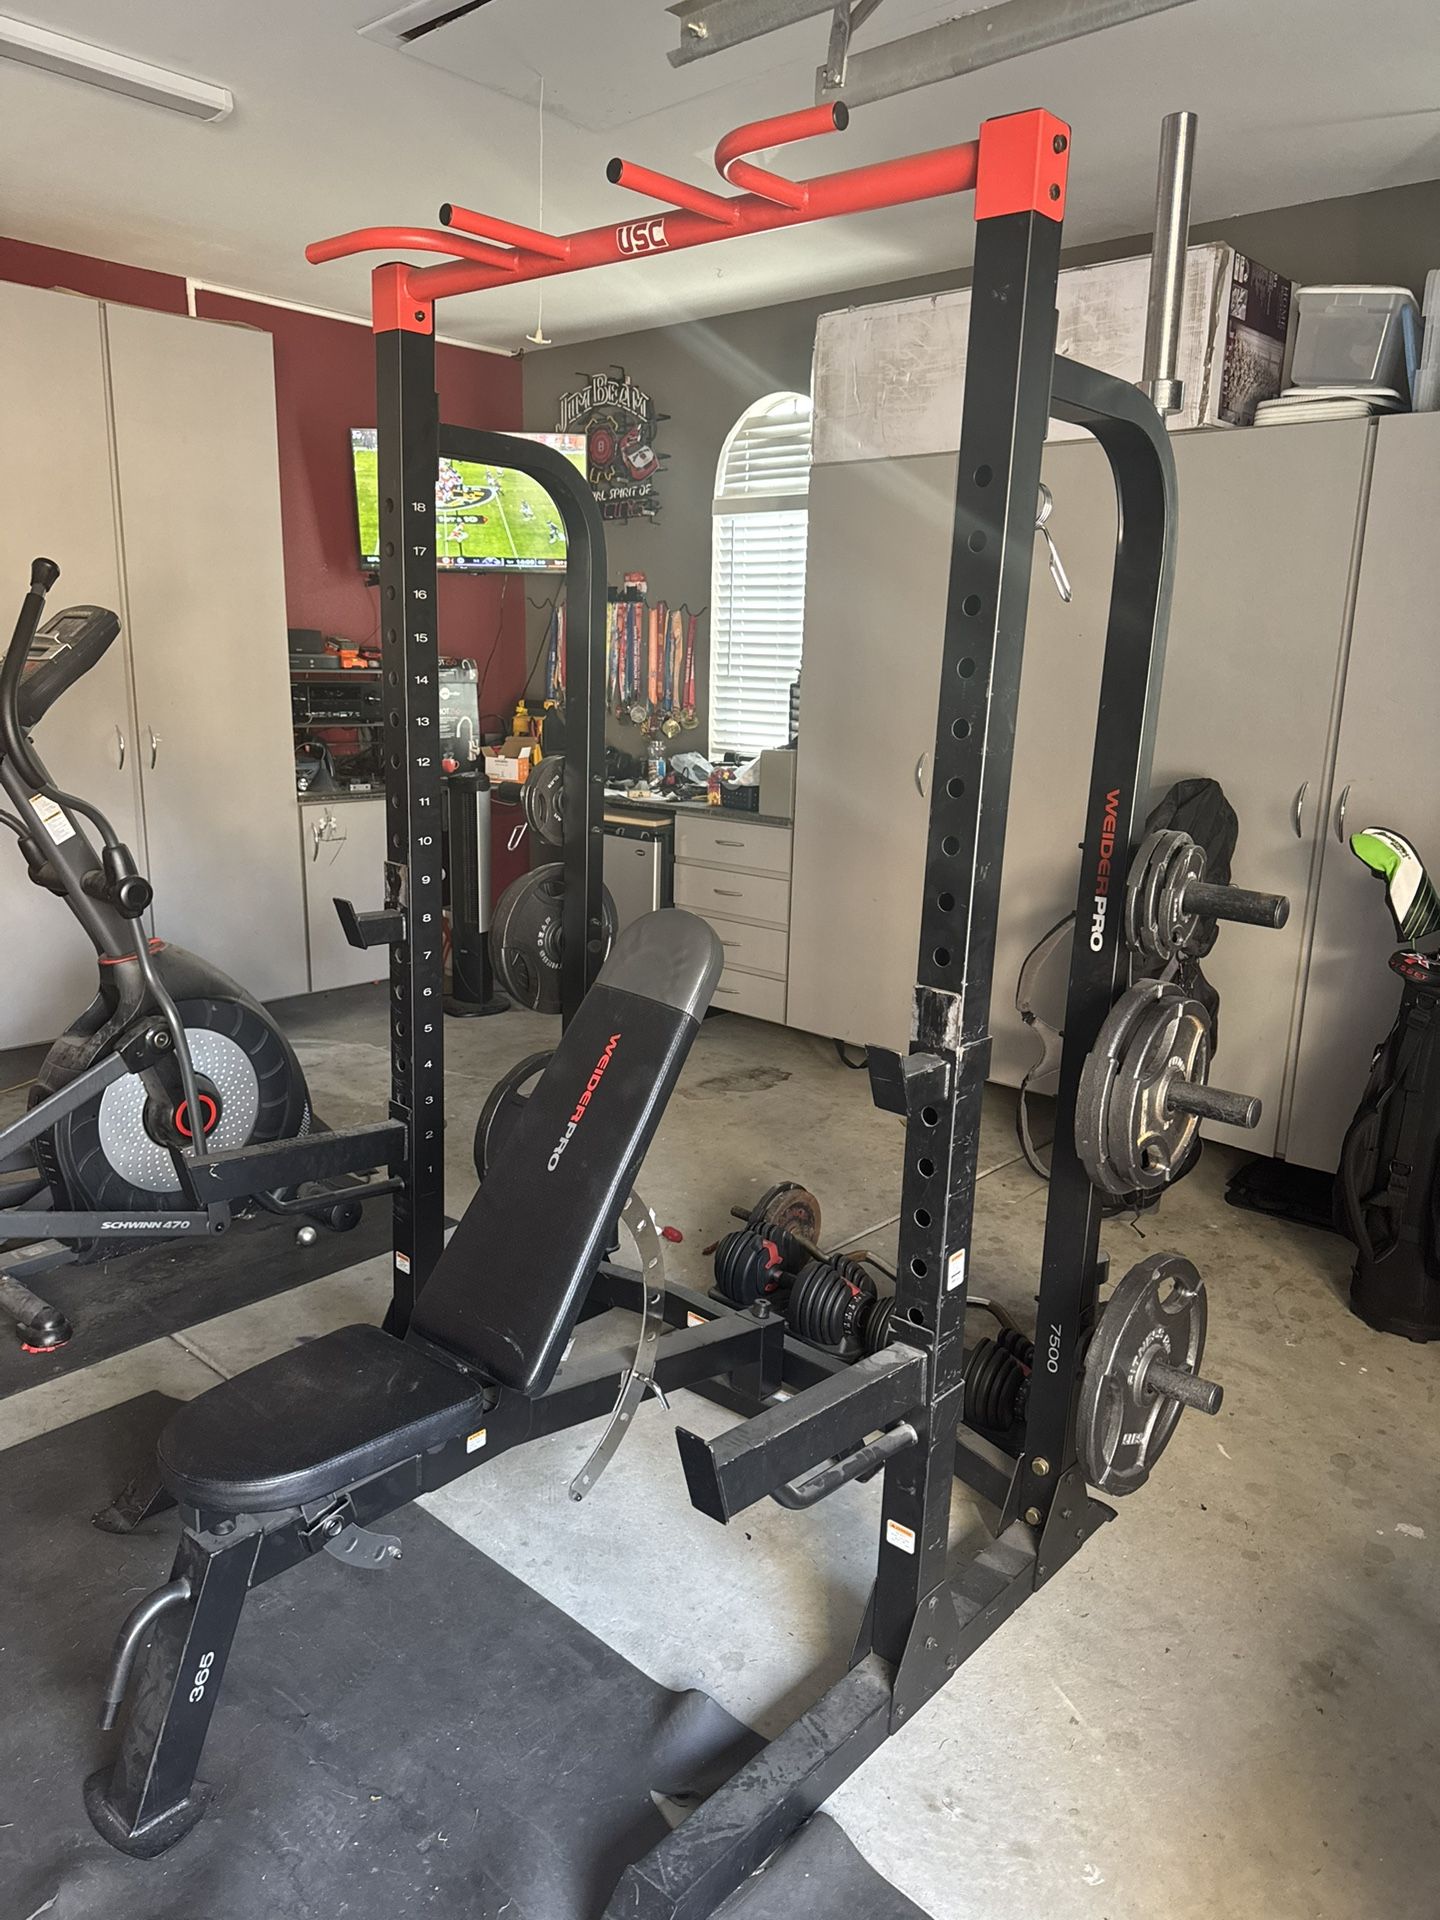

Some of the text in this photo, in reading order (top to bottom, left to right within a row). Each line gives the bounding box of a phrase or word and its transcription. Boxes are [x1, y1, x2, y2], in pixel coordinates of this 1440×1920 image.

[616, 218, 669, 255] USC
[556, 373, 650, 433] JIM BEAM
[609, 486, 638, 500] SPIRIT
[638, 483, 652, 496] OF
[412, 502, 427, 513] 18
[412, 546, 427, 557] 17
[413, 589, 428, 600] 16
[414, 632, 428, 643] 15
[415, 675, 429, 685] 14
[416, 716, 430, 727] 13
[417, 757, 431, 767] 12
[418, 796, 431, 807] 11
[418, 836, 432, 846] 10
[421, 875, 431, 885] 9
[422, 913, 432, 923] 8
[423, 950, 432, 960] 7
[423, 987, 432, 997] 6
[424, 1023, 433, 1033] 5
[424, 1059, 433, 1069] 4
[425, 1095, 434, 1105] 3
[425, 1129, 434, 1139] 2
[428, 1164, 433, 1174] 1
[100, 1220, 191, 1230] SCHWINN 470
[1046, 1324, 1062, 1373] 7500
[189, 1651, 215, 1703] 365
